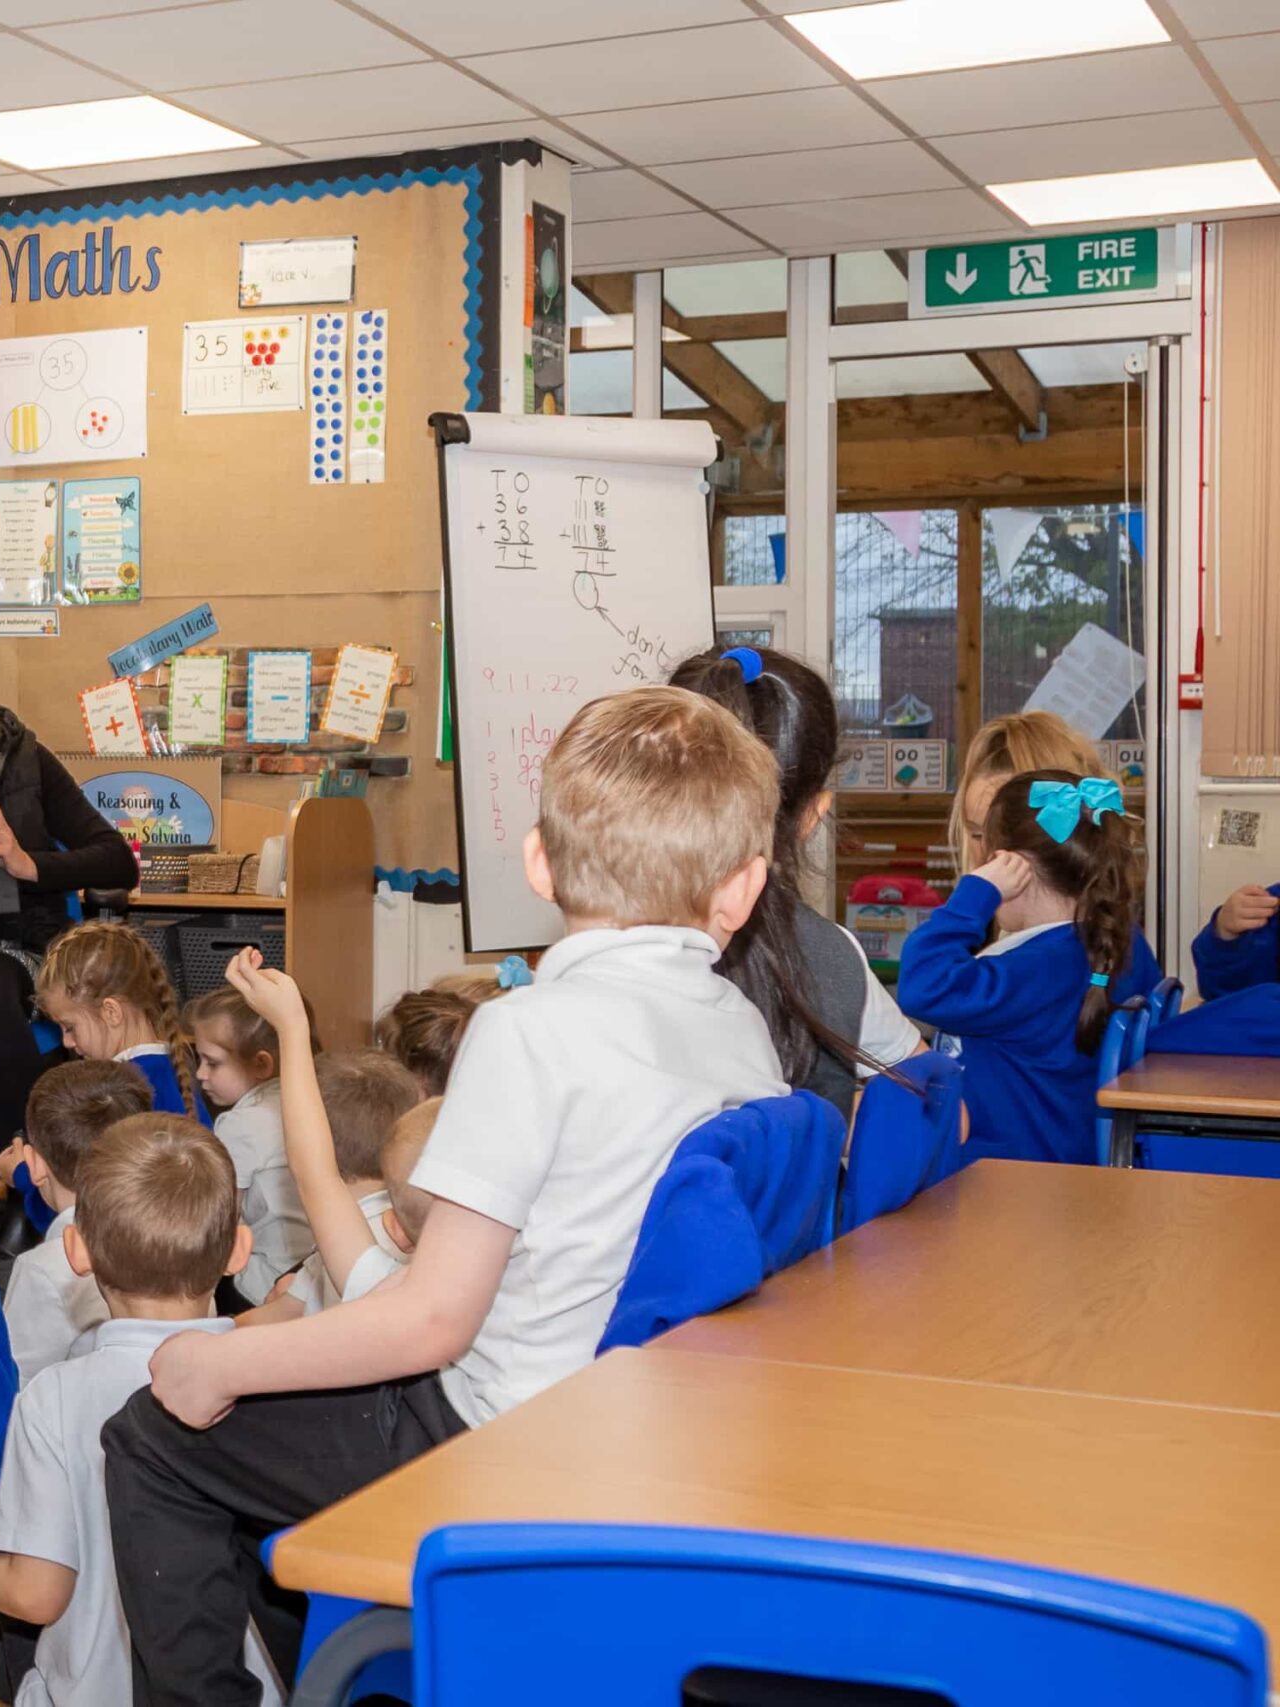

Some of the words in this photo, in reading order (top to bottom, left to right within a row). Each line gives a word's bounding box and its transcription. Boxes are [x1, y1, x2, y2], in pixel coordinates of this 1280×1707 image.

[1077, 237, 1136, 261] FIRE
[1077, 266, 1136, 289] EXIT
[195, 335, 228, 362] 35
[47, 352, 73, 379] 35
[257, 377, 280, 393] five
[895, 749, 918, 761] oo
[1120, 751, 1143, 763] ou
[97, 791, 164, 816] Reasoning
[170, 792, 180, 809] &
[494, 819, 506, 841] 5
